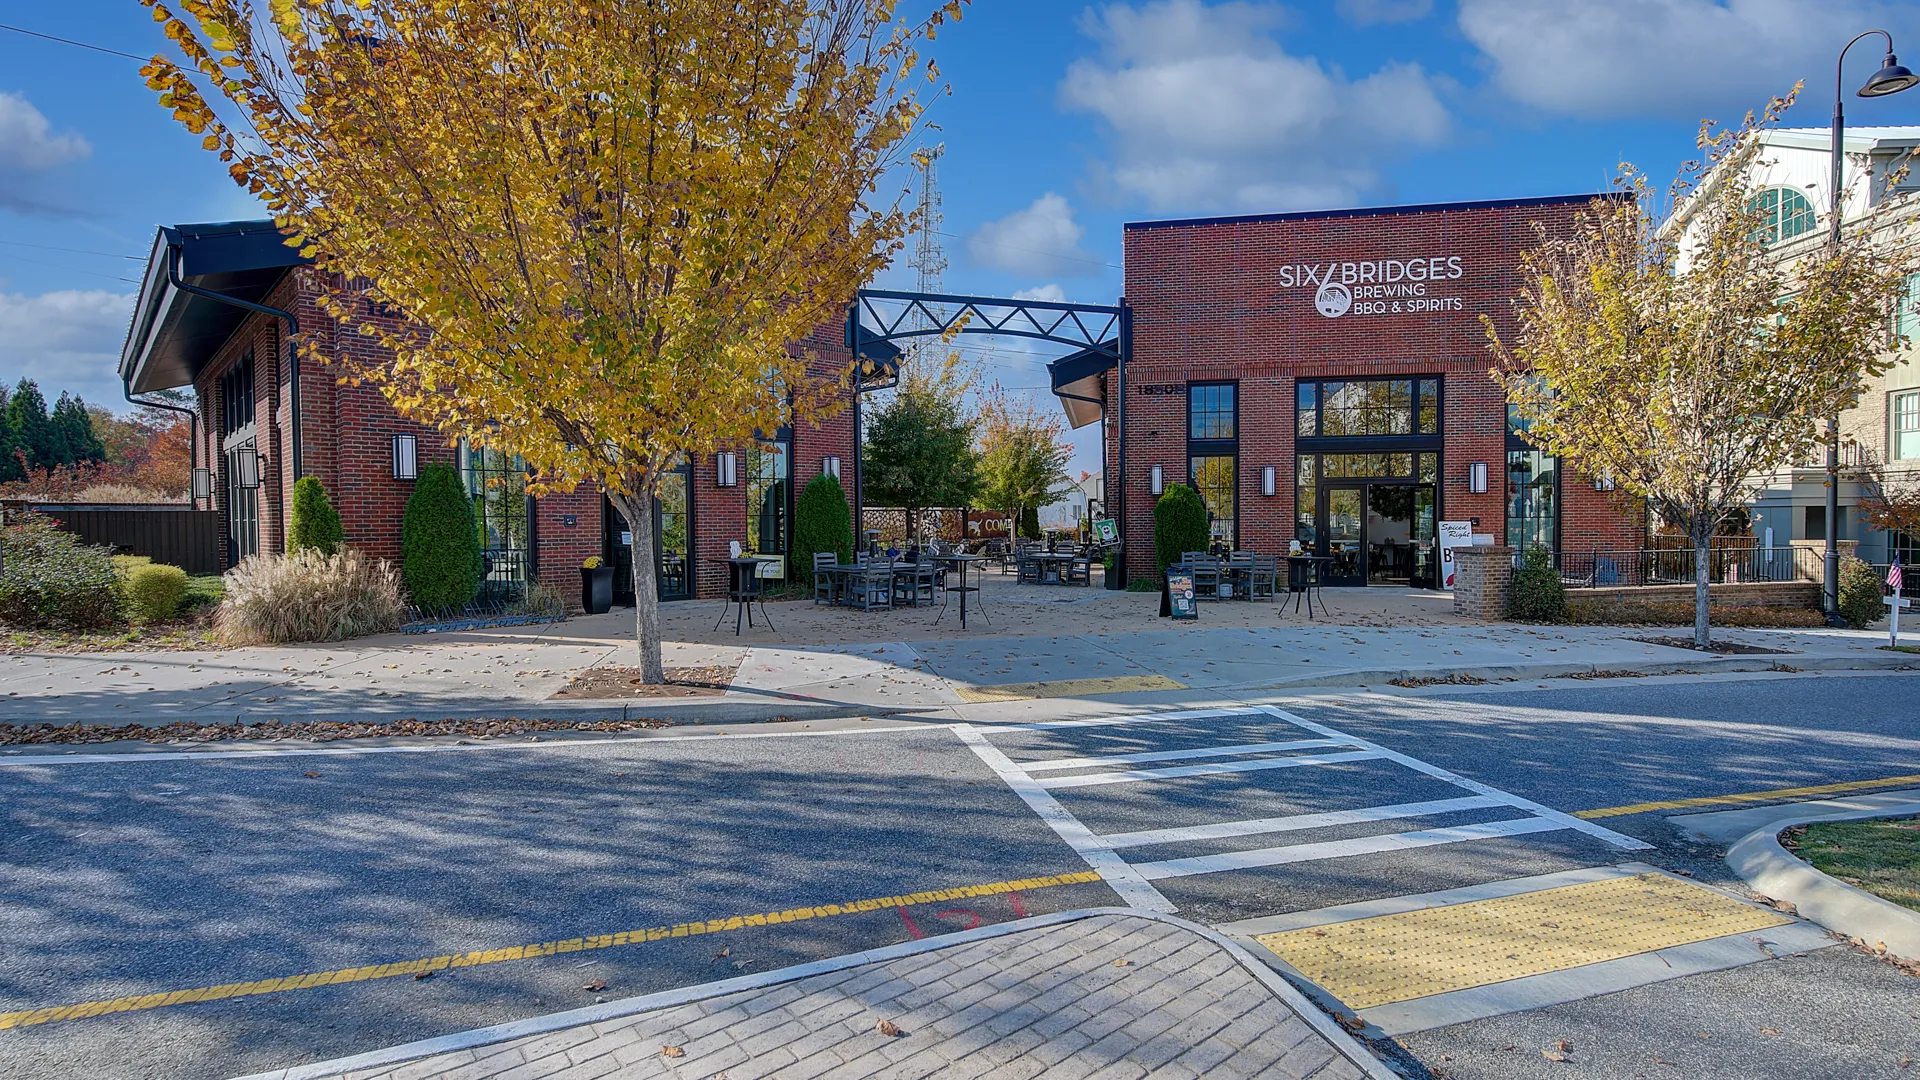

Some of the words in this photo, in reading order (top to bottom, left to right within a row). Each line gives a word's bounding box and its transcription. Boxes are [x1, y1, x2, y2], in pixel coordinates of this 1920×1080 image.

[1279, 264, 1321, 288] SIX
[1314, 263, 1352, 318] 6
[1341, 256, 1463, 284] BRIDGES
[1353, 283, 1425, 299] BREWING
[1353, 301, 1386, 315] BBQ
[1391, 301, 1402, 313] &
[1407, 298, 1463, 313] SPIRITS
[1441, 523, 1468, 531] Spiced
[1448, 530, 1470, 539] Right
[1443, 547, 1454, 562] B
